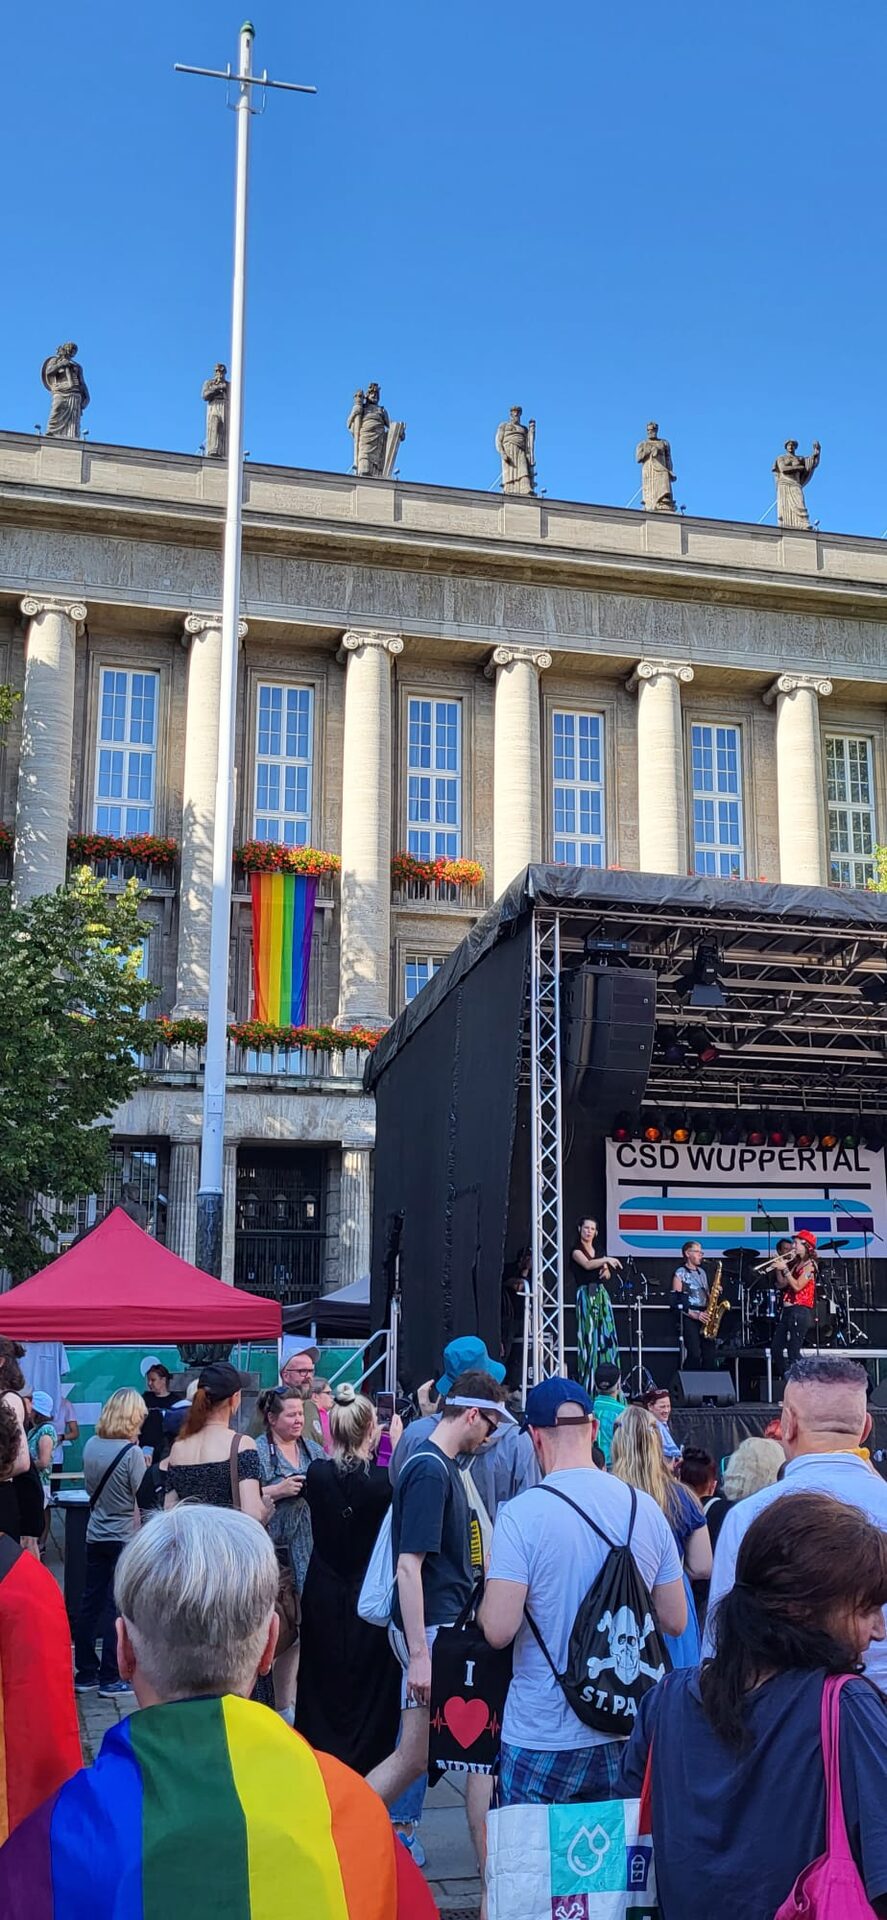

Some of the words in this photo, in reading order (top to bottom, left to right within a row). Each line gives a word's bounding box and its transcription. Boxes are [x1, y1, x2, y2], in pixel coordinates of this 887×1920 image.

[616, 1143, 680, 1170] CSD
[687, 1146, 871, 1172] WUPPERTAL
[464, 1660, 476, 1686] I
